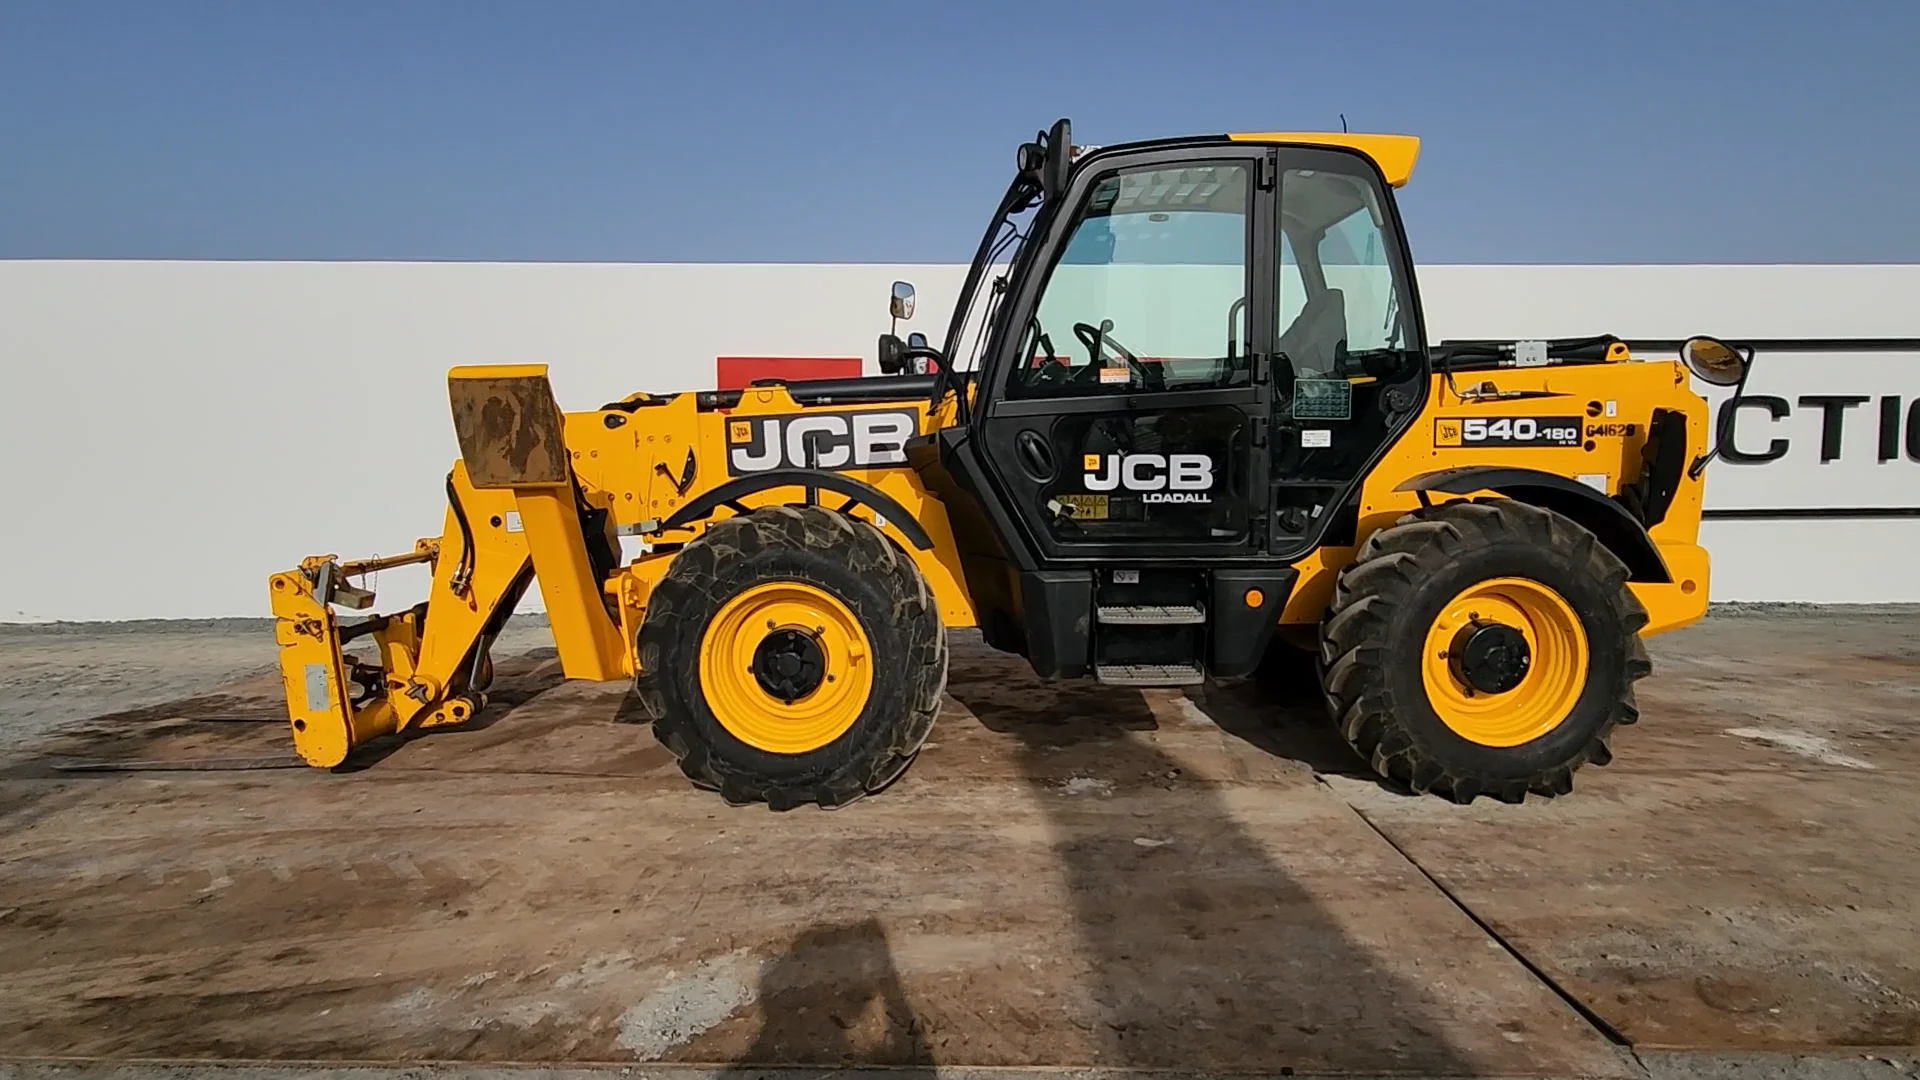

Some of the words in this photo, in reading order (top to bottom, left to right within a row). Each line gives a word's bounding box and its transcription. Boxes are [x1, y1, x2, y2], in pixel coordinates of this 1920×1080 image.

[731, 412, 914, 472] JCB
[1441, 425, 1458, 440] JCB
[1701, 395, 1920, 464] CTI
[1084, 454, 1214, 490] JCB
[1142, 493, 1212, 503] LOADALL
